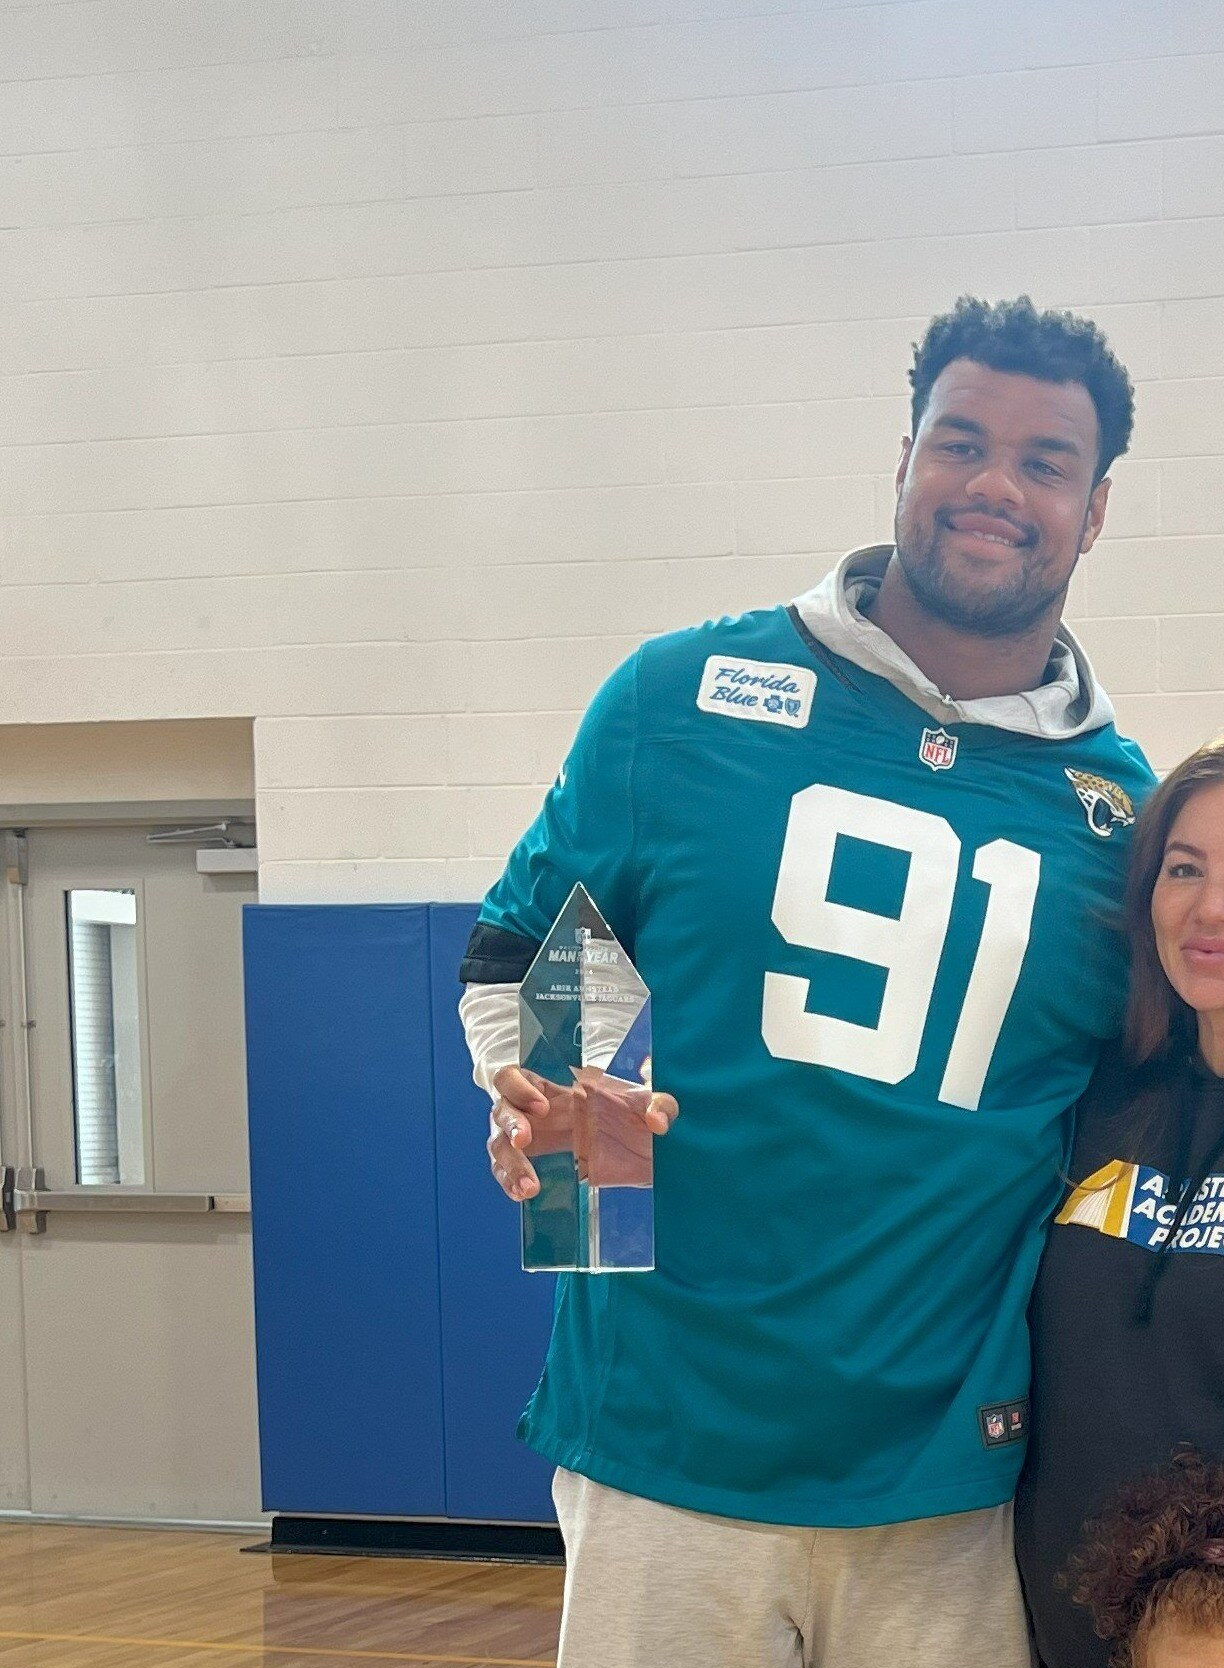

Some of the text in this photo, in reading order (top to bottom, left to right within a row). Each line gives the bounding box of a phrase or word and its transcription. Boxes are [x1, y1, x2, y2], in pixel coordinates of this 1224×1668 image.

[714, 668, 800, 693] Florida
[709, 686, 759, 706] Blue
[925, 744, 949, 763] NFL
[548, 950, 576, 962] MAN
[586, 951, 619, 964] YEAR
[761, 783, 1041, 1111] 91
